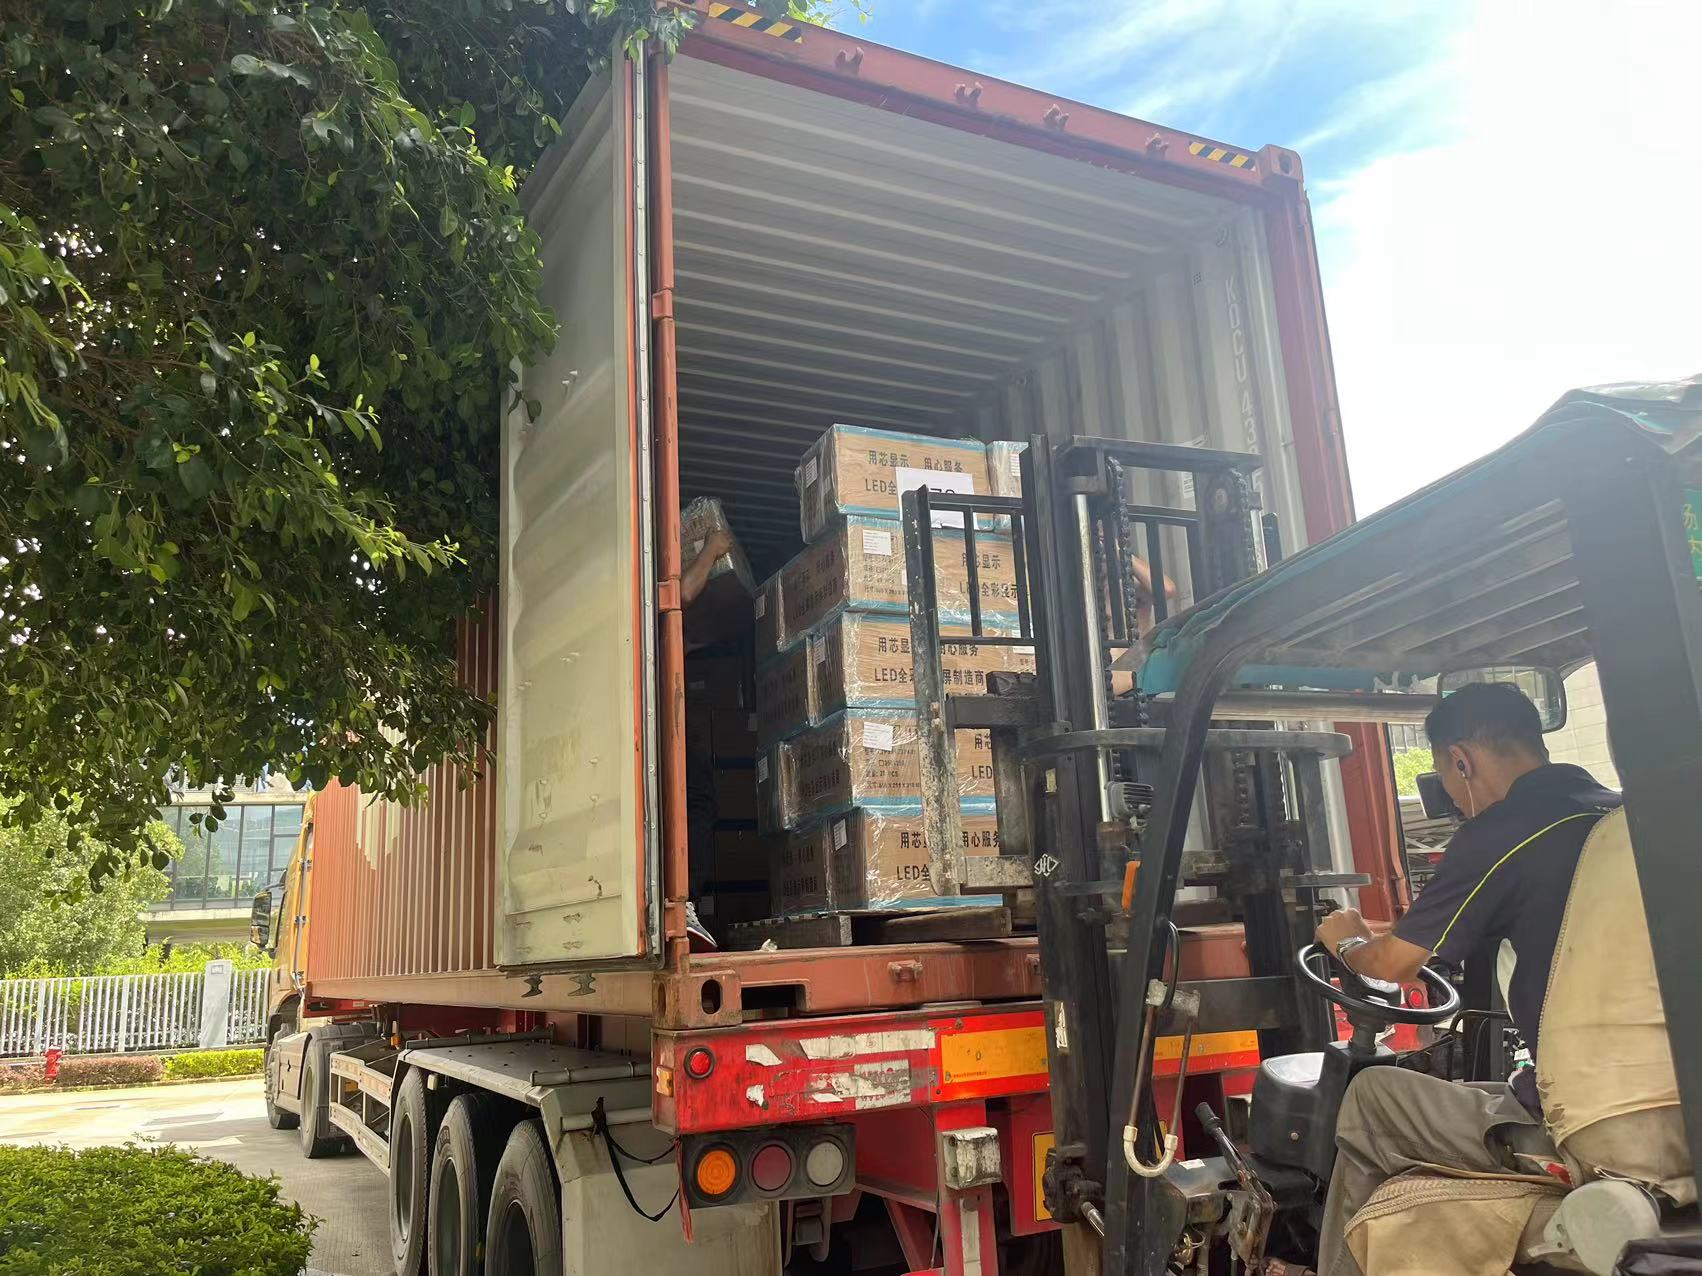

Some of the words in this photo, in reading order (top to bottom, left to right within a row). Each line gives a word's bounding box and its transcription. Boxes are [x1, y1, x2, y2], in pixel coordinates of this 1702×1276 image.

[868, 449, 910, 468] 用芯显示
[971, 765, 993, 780] LED
